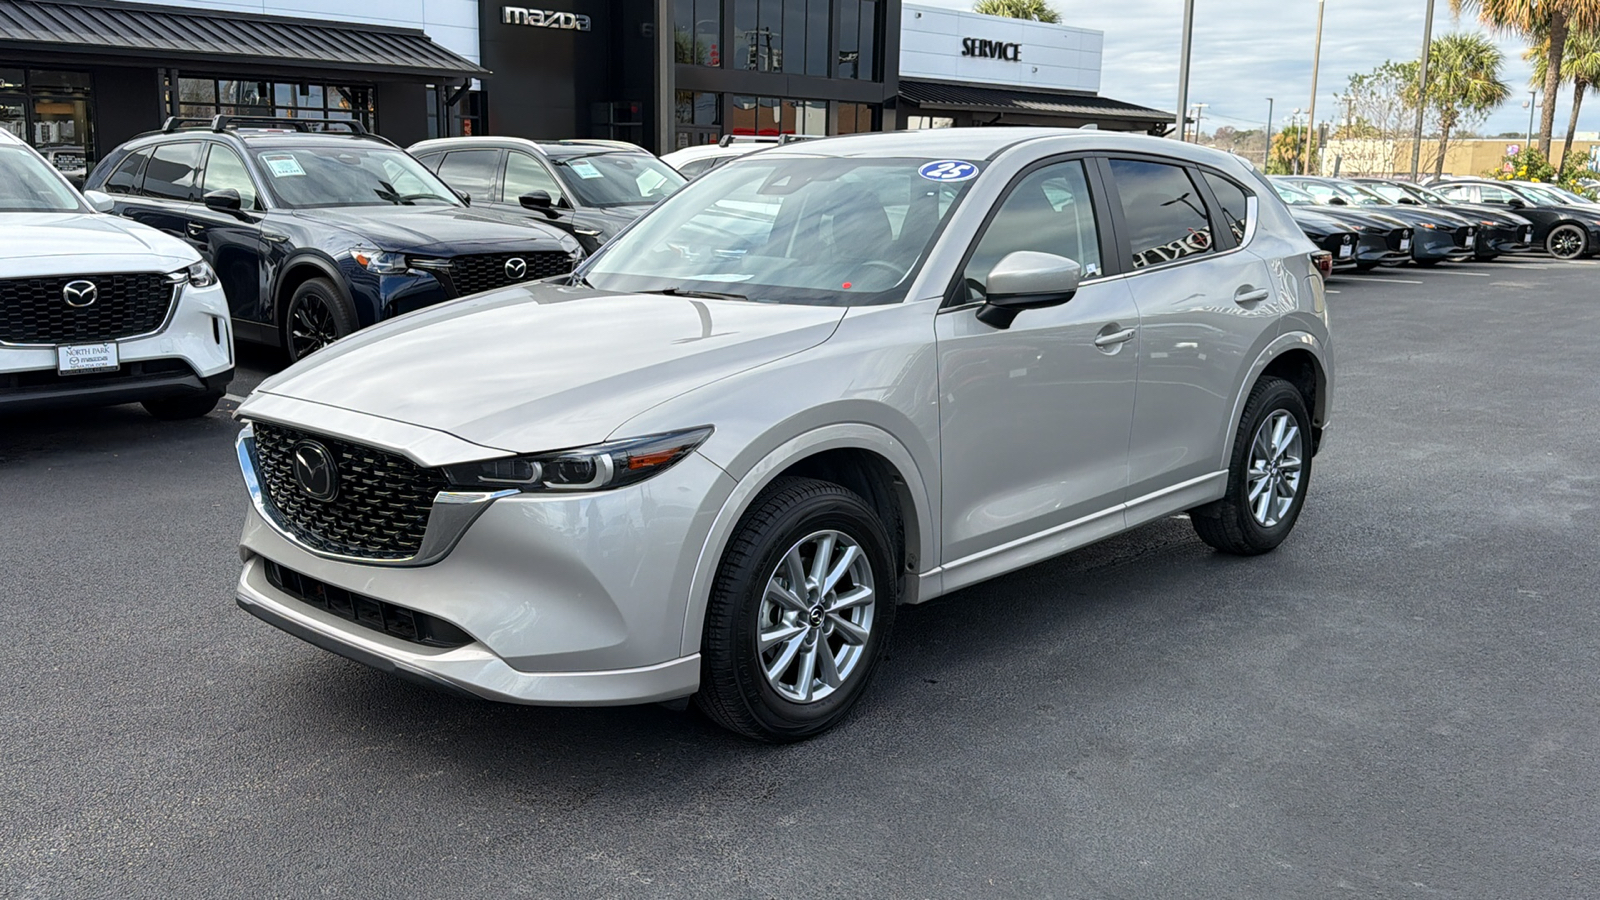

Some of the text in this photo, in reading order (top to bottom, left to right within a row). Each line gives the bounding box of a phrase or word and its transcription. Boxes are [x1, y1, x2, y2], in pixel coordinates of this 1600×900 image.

[502, 6, 591, 32] mazda
[961, 37, 1022, 62] SERVICE
[926, 162, 972, 179] 25
[66, 346, 110, 357] NORTH PARK
